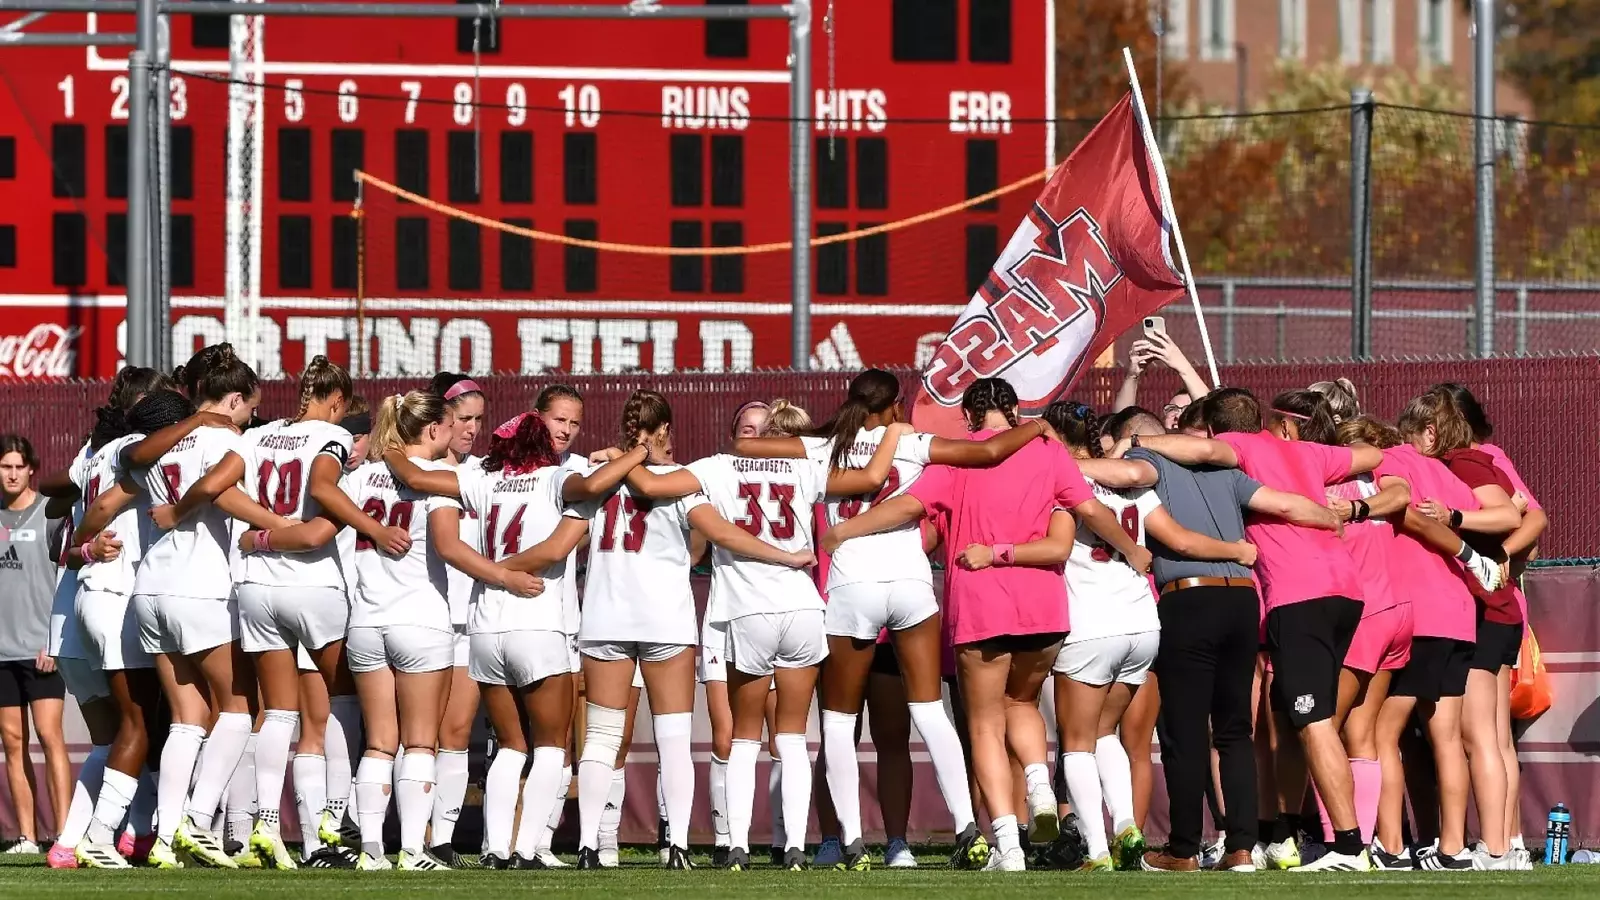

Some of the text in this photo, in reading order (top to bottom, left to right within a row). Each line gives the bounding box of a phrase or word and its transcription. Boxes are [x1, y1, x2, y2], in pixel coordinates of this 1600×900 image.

[58, 75, 1012, 134] 1 2 3 5 6 7 8 9 10 RUNS HITS ERR
[518, 318, 753, 375] FIELD
[258, 459, 303, 516] 10
[733, 482, 796, 541] 33
[486, 501, 528, 561] 14
[597, 492, 648, 553] 13
